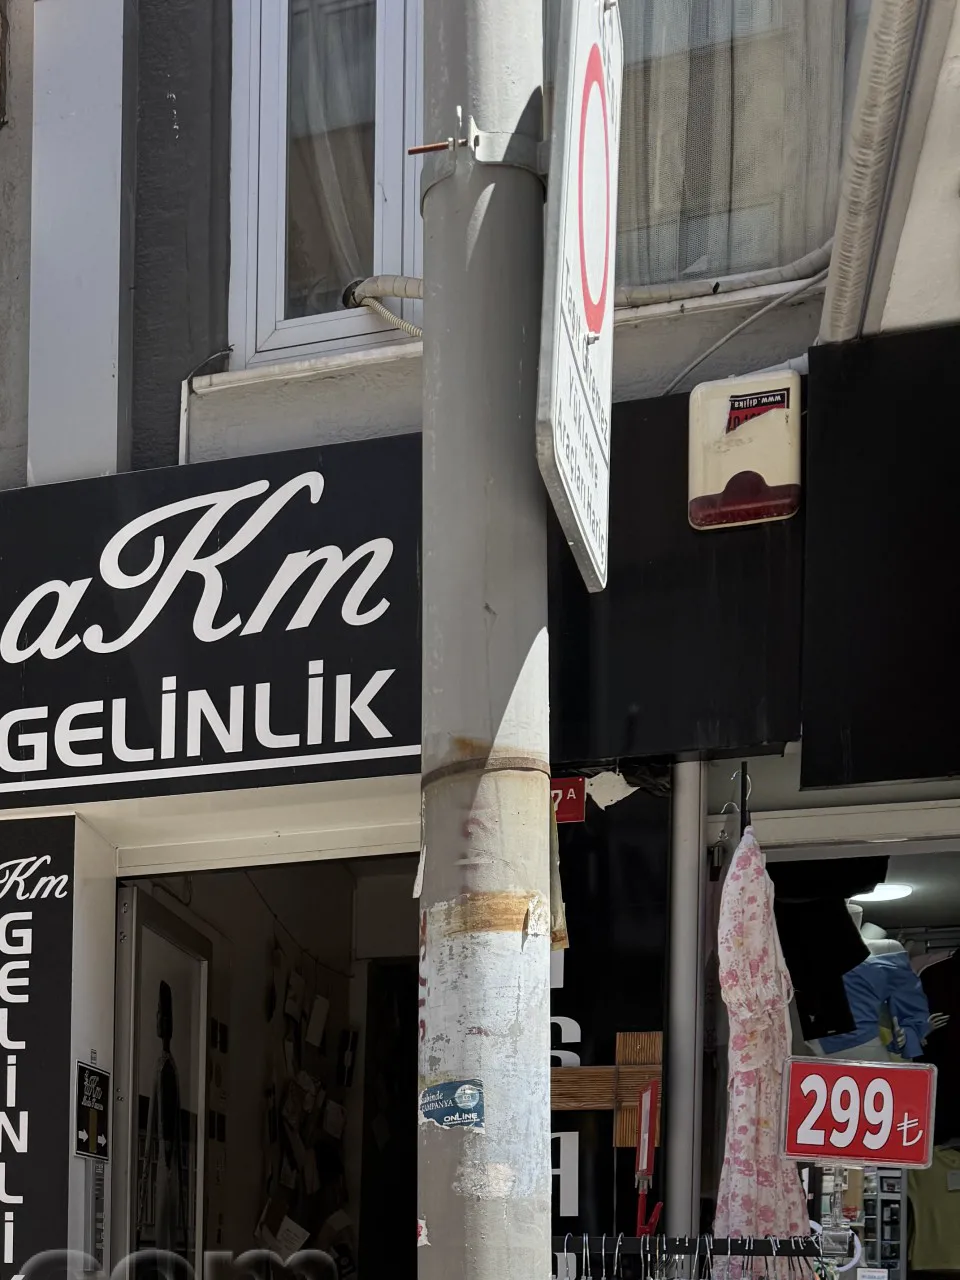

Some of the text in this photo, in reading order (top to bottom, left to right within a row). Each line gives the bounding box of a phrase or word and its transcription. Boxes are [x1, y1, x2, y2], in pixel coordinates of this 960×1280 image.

[557, 397, 605, 566] Araçları Hariç
[568, 366, 599, 489] Yükleme
[0, 470, 395, 664] aKm
[443, 1112, 478, 1122] ONLINE
